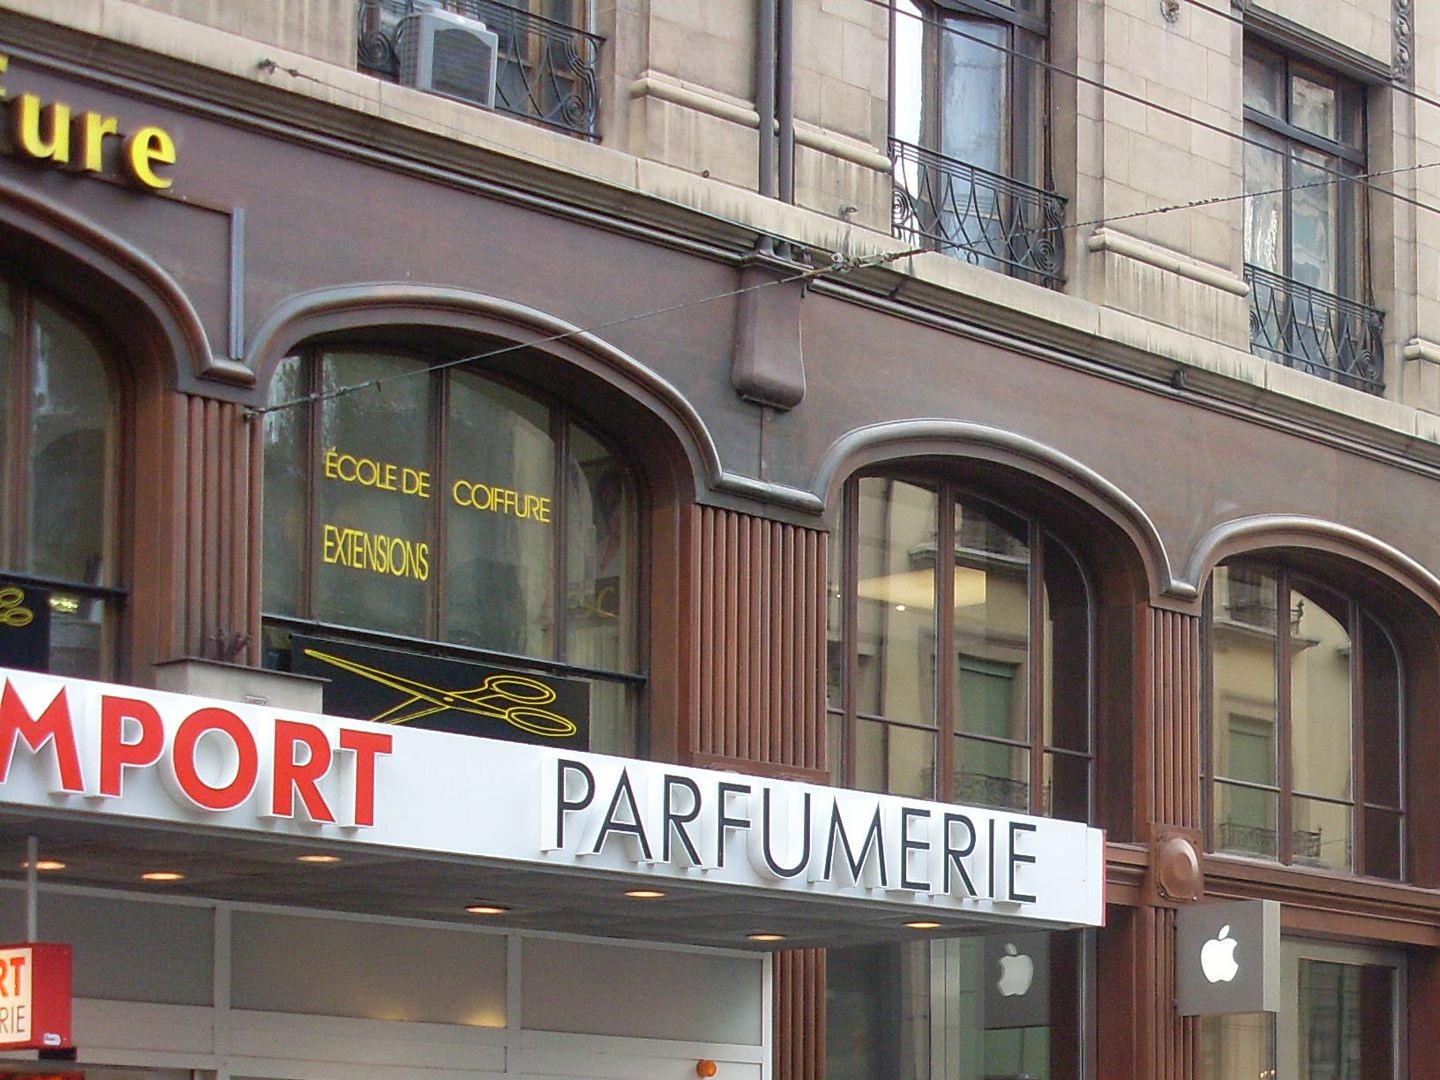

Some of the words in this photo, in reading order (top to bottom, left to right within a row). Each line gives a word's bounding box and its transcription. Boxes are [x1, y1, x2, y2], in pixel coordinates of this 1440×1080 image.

[325, 446, 398, 491] ÉCOLE
[402, 468, 430, 498] DE
[452, 480, 550, 523] COIFFURE
[323, 524, 429, 582] EXTENSIONS
[557, 757, 1037, 904] PARFUMERIE
